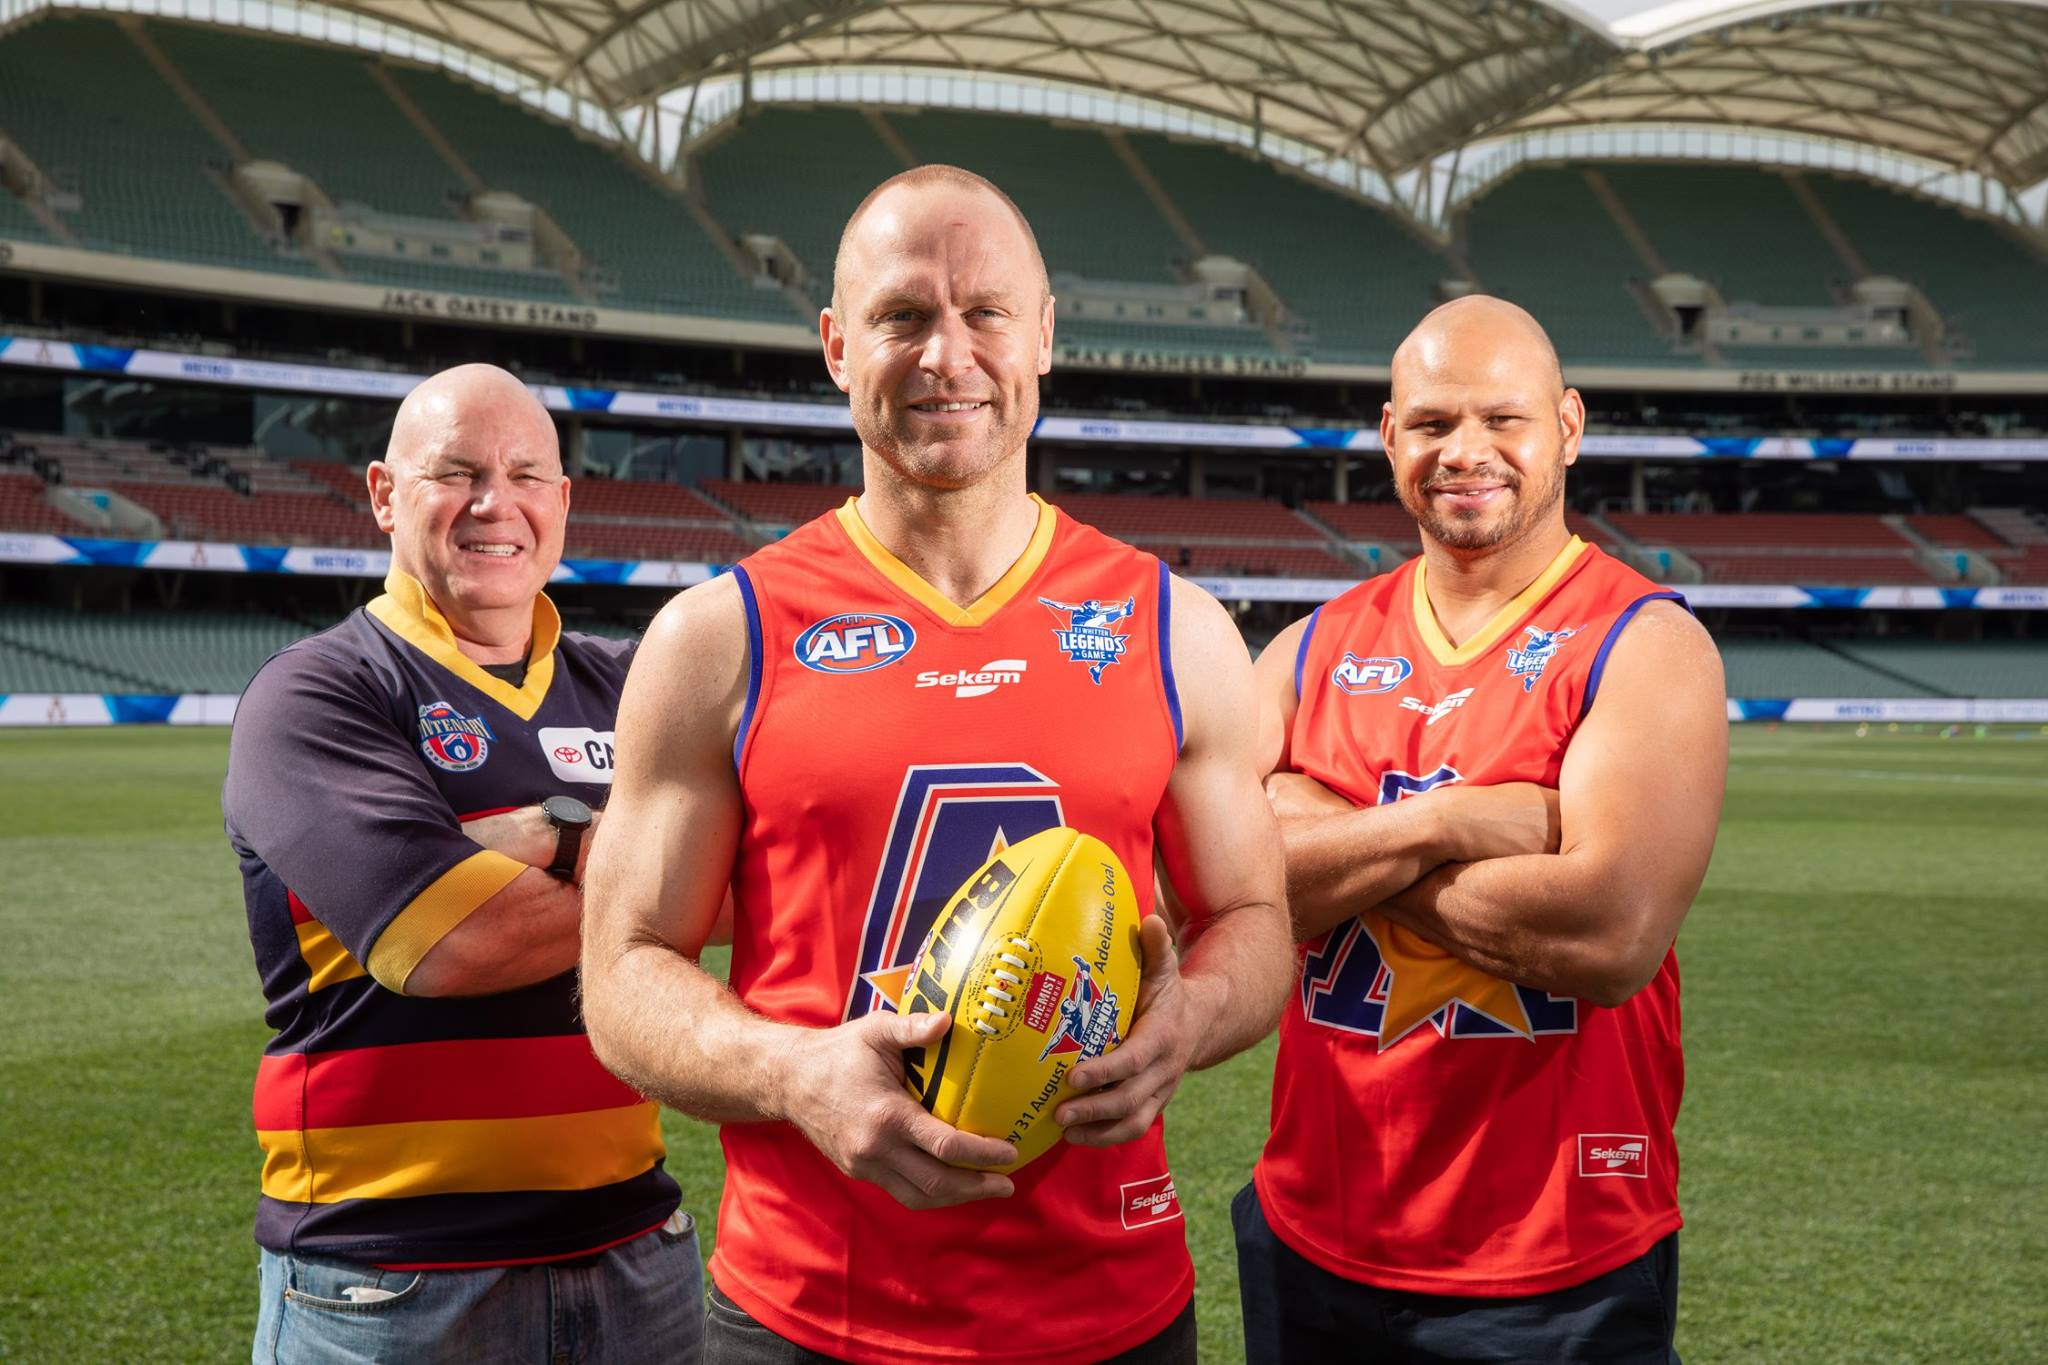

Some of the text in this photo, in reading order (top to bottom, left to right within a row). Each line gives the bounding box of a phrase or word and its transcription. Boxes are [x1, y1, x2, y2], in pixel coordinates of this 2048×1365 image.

[382, 292, 598, 328] JACK OATEY STAND
[1234, 355, 1307, 378] STAND
[805, 623, 906, 662] AFL
[1061, 633, 1124, 652] LEGENDS
[1081, 650, 1106, 659] GAME
[915, 669, 1021, 688] Sekem
[1336, 660, 1401, 684] AFL
[419, 717, 492, 739] NTENARY
[1094, 862, 1115, 975] Adelaide Oval
[1027, 974, 1056, 1027] CHEMIST
[1100, 1020, 1114, 1045] GAME
[1014, 1112, 1035, 1130] 31
[1030, 1060, 1068, 1112] August
[1589, 1148, 1639, 1160] Sekem
